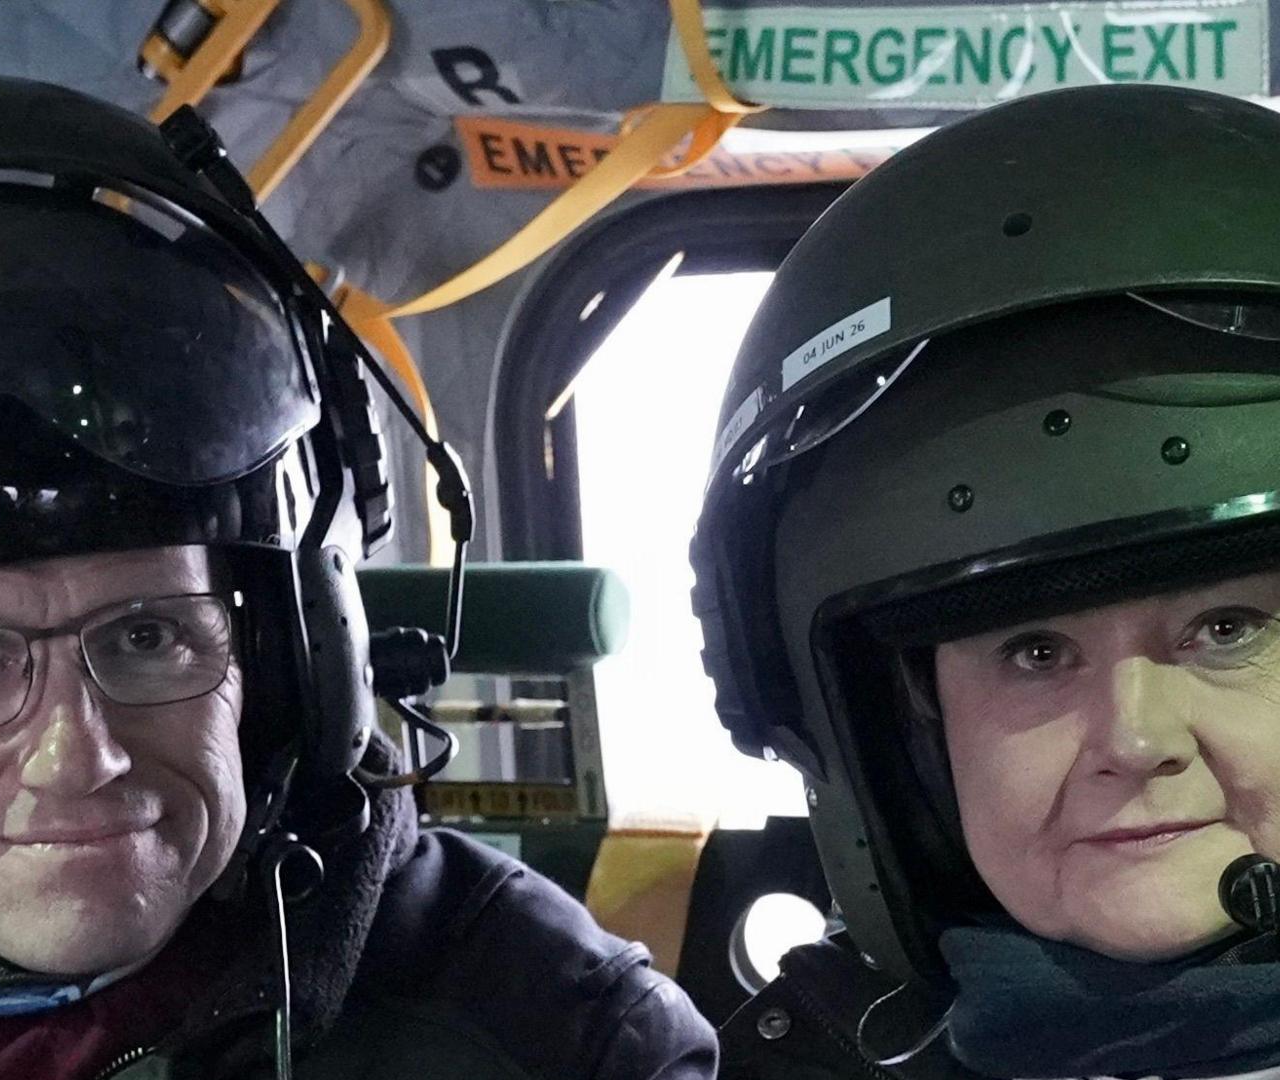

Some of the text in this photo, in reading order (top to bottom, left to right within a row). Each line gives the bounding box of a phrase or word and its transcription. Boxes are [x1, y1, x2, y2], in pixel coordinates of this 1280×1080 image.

[430, 46, 521, 104] R
[1103, 20, 1237, 81] EXIT
[479, 131, 822, 178] EMENCY
[803, 319, 866, 365] 04 JUN 26
